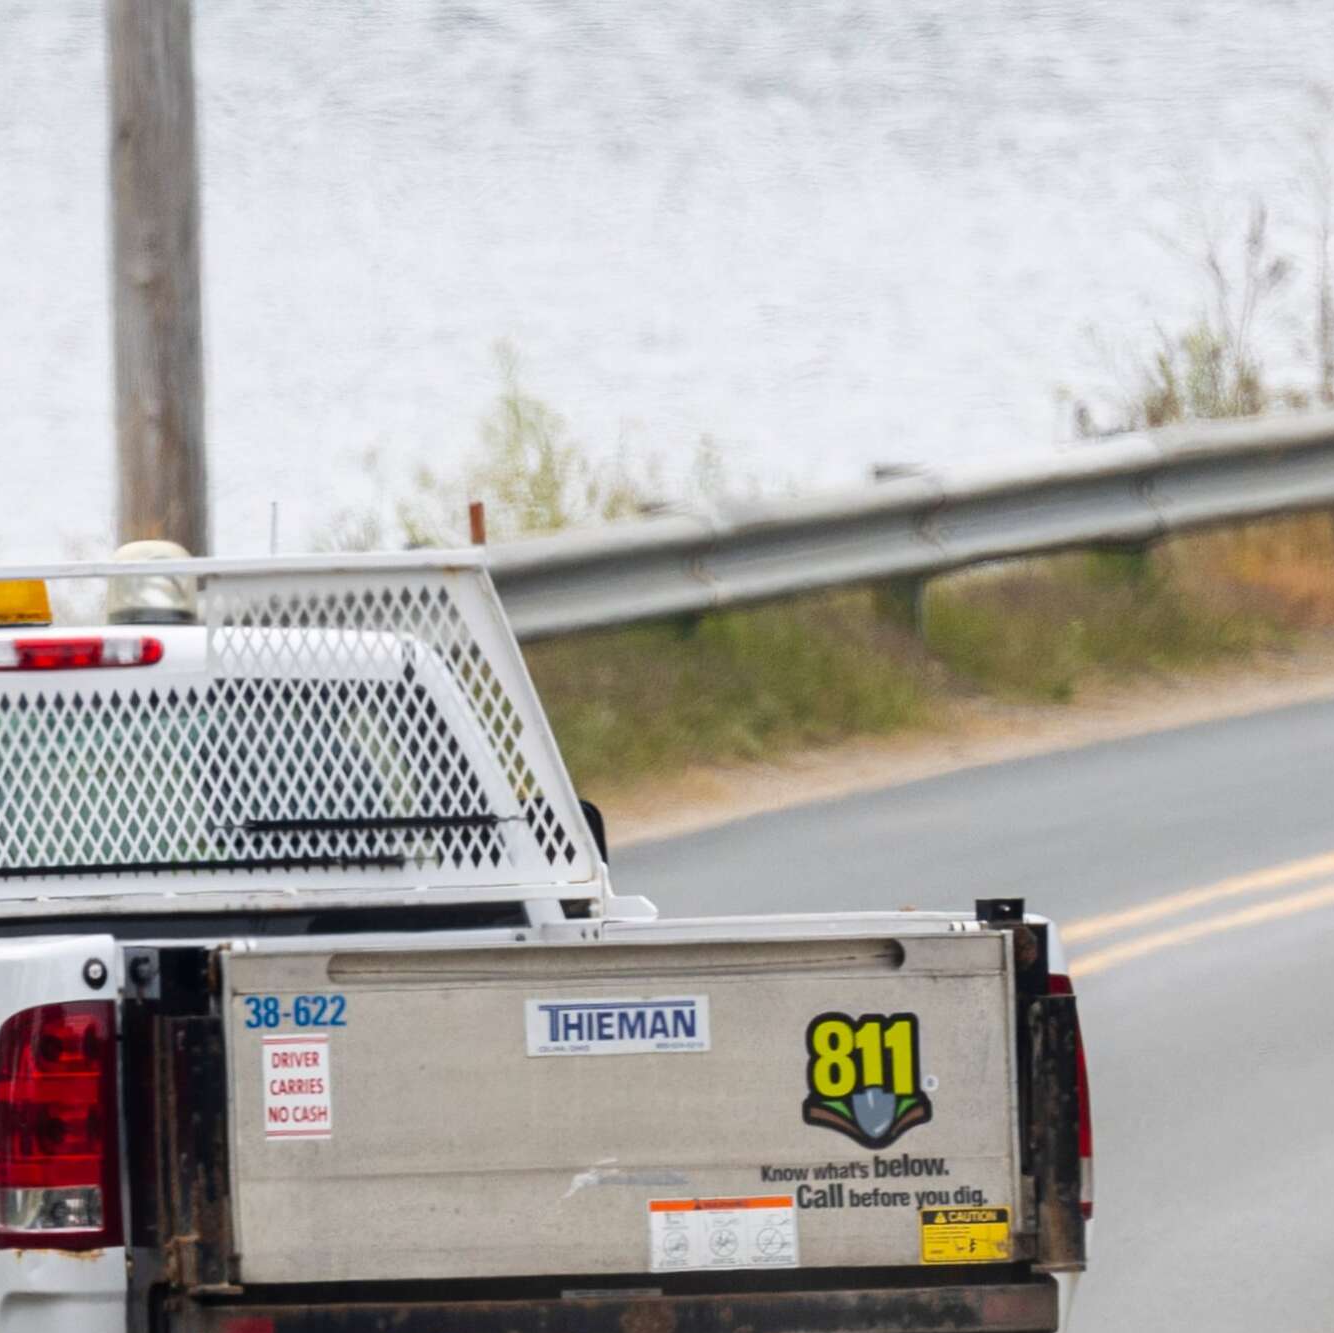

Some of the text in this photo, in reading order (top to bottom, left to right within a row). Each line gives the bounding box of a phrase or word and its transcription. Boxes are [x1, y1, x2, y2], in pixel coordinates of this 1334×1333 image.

[244, 994, 347, 1028] 38-622
[538, 1000, 696, 1042] THIEMAN
[271, 1051, 320, 1068] DRIVER
[811, 1018, 916, 1098] 811
[270, 1078, 324, 1095] CARRIES
[268, 1106, 328, 1123] NO CASH
[760, 1153, 950, 1182] Know what's below.
[796, 1184, 988, 1210] Call before you dig.
[948, 1211, 997, 1222] CAUTION
